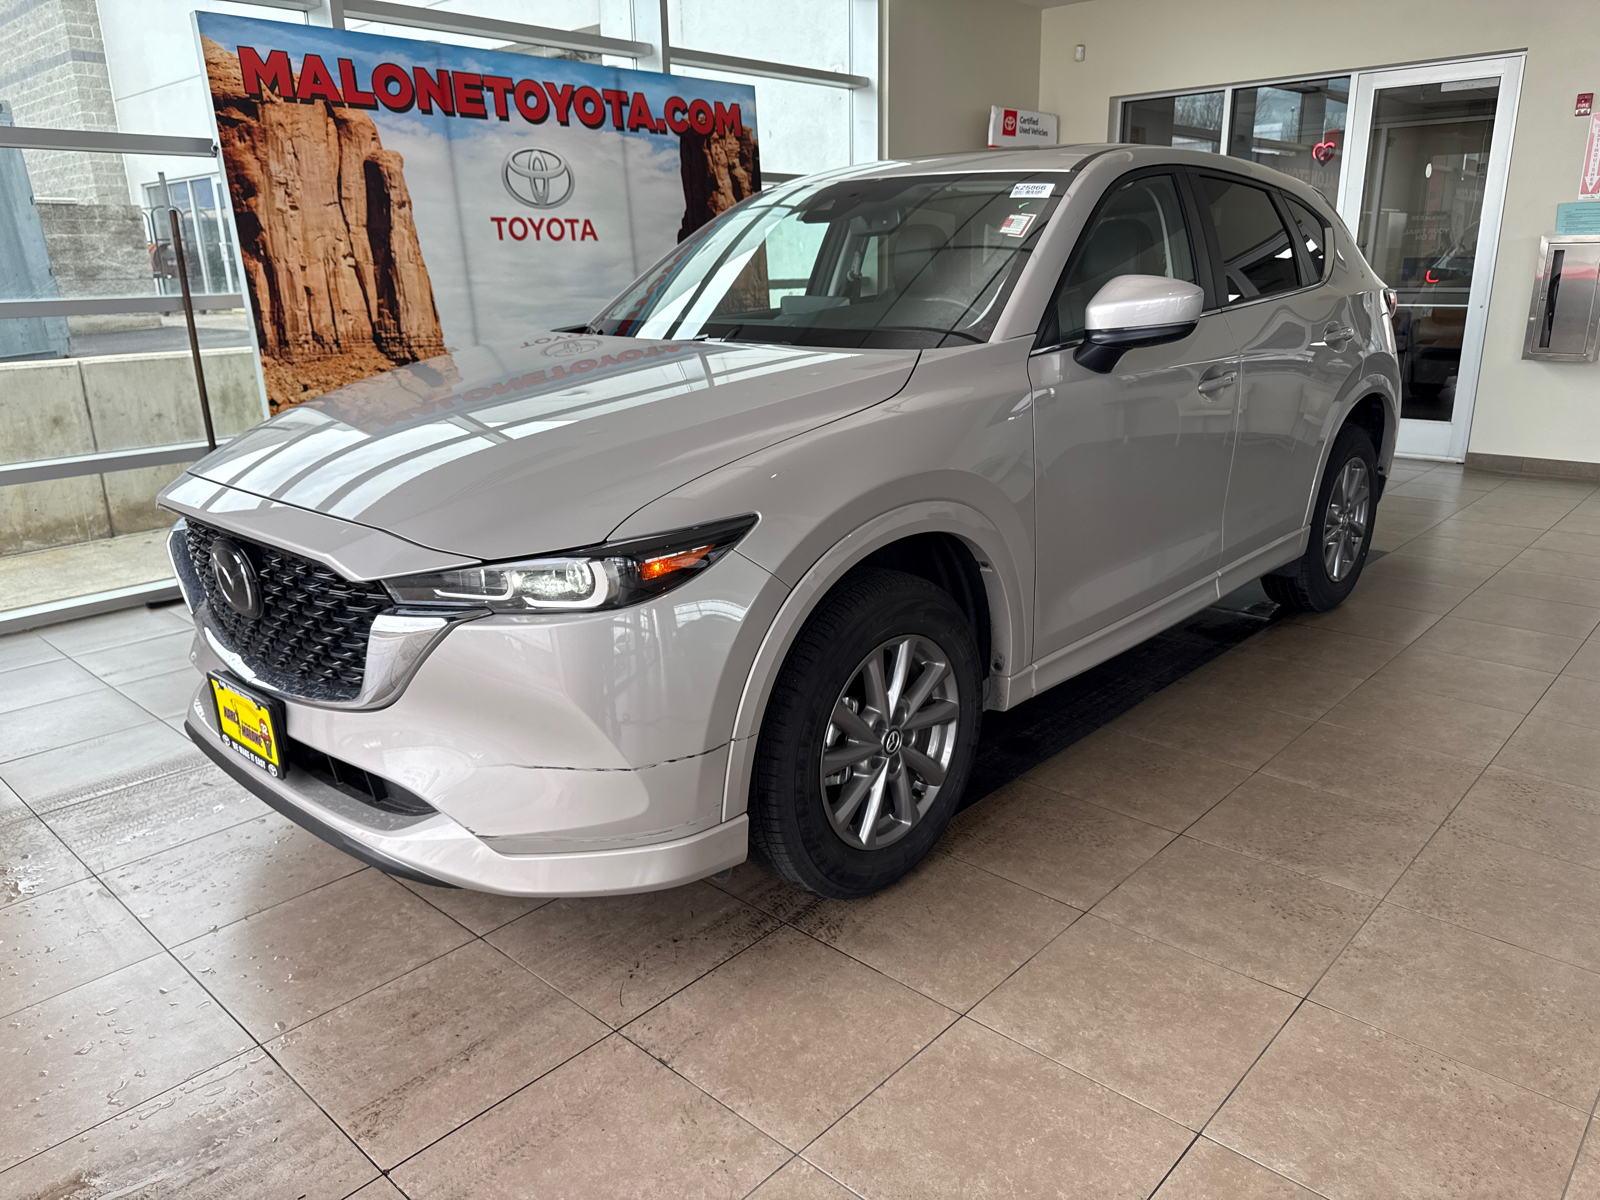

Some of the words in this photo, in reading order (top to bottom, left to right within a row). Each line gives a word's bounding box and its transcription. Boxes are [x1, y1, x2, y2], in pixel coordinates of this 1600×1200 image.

[236, 45, 742, 137] MALONETOYOTA.COM
[1019, 116, 1039, 126] Certified
[1019, 125, 1030, 135] Used
[1030, 127, 1048, 137] Vehicles
[490, 217, 599, 242] TOYOTA
